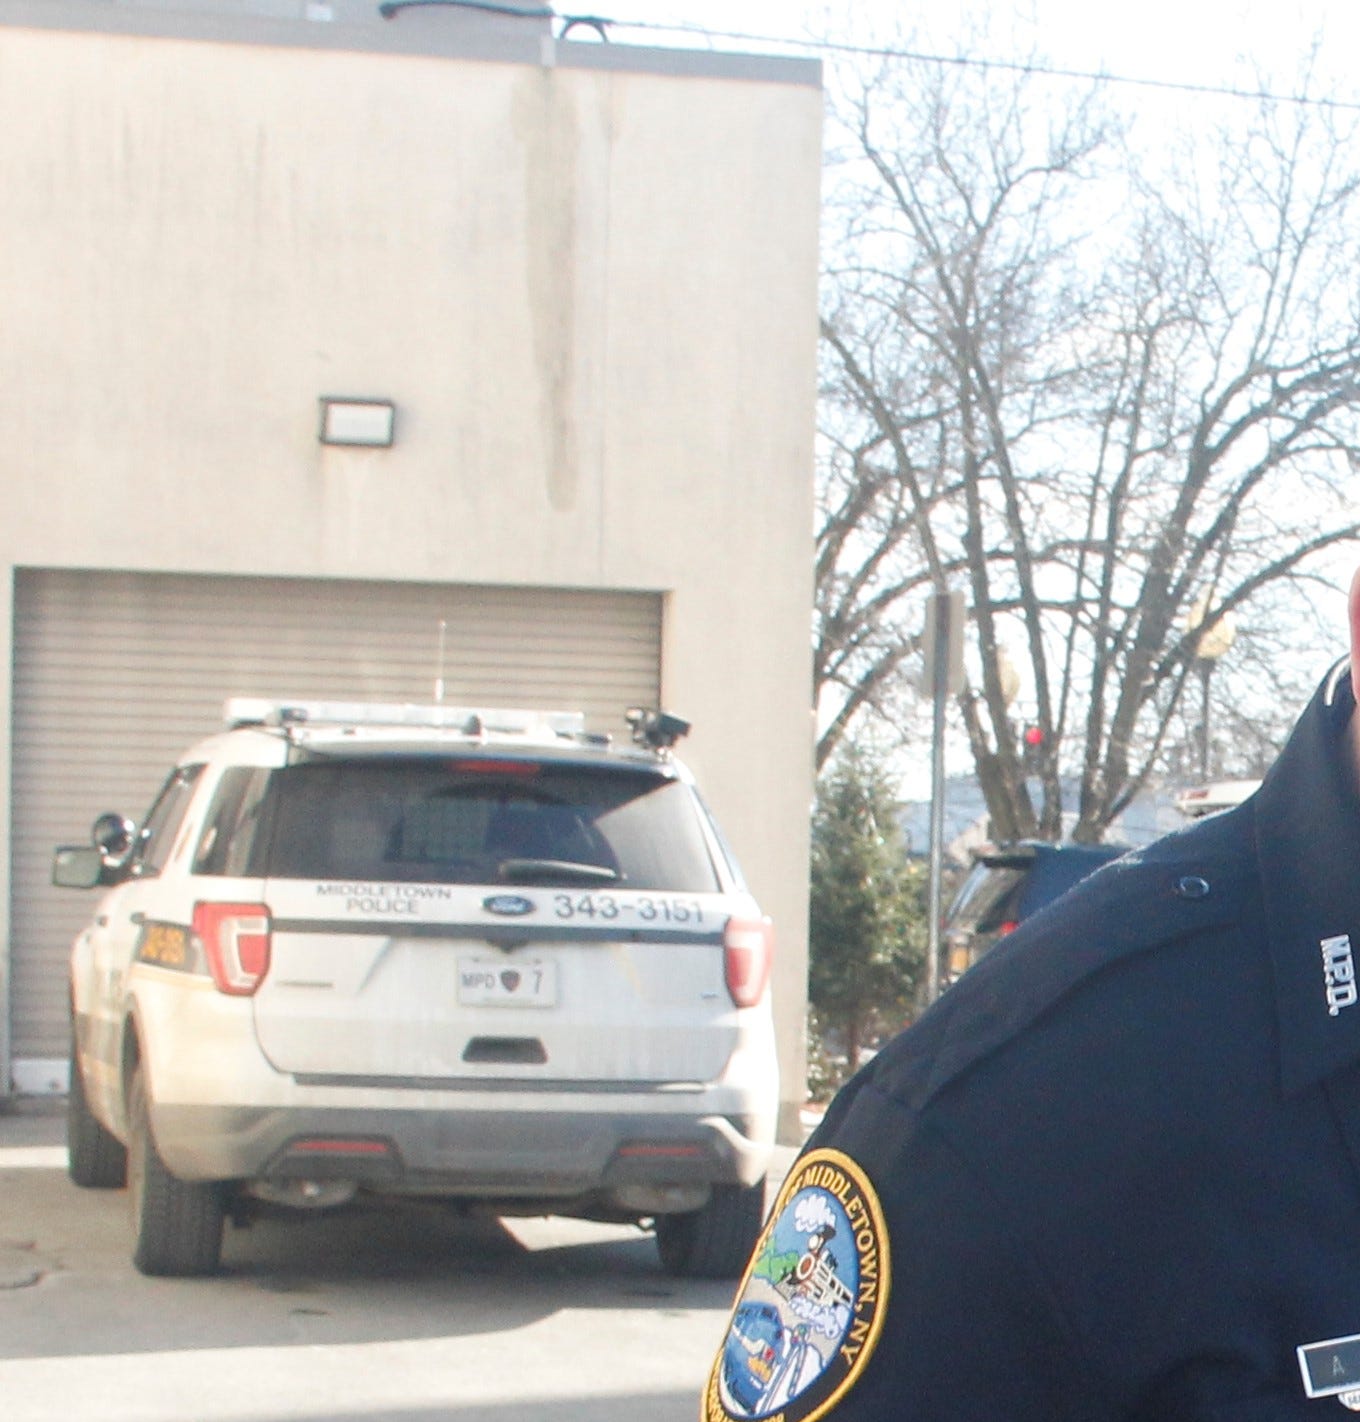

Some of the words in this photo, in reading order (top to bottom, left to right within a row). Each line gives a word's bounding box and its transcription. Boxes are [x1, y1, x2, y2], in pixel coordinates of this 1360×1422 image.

[317, 884, 451, 899] MIDDLETOWN
[347, 898, 419, 913] POLICE
[554, 895, 703, 922] 343-3151
[841, 1318, 870, 1366] NY
[1332, 1355, 1345, 1376] A
